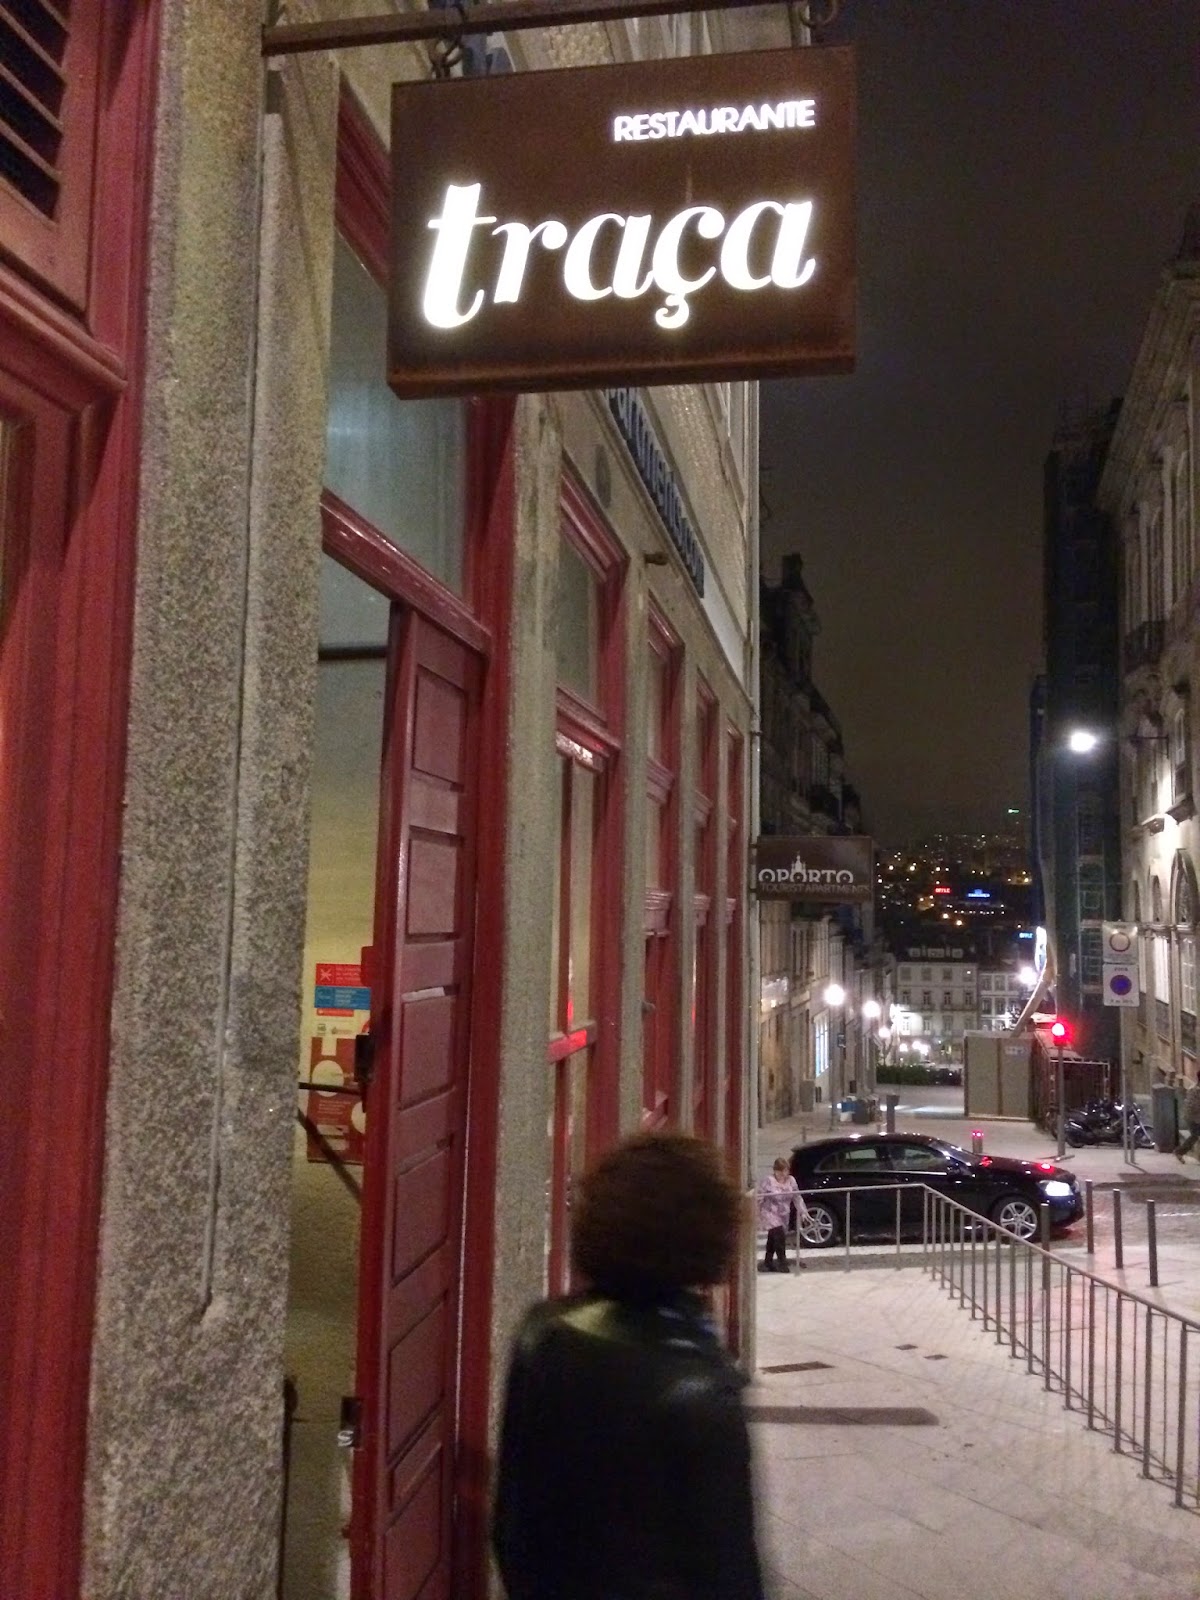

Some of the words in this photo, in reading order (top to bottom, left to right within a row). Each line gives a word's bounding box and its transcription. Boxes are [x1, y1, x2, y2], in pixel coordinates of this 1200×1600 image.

[613, 99, 816, 141] RESTAURANTE
[423, 183, 816, 329] traça
[758, 867, 854, 884] OPORTO
[805, 884, 871, 893] APARTMENTS
